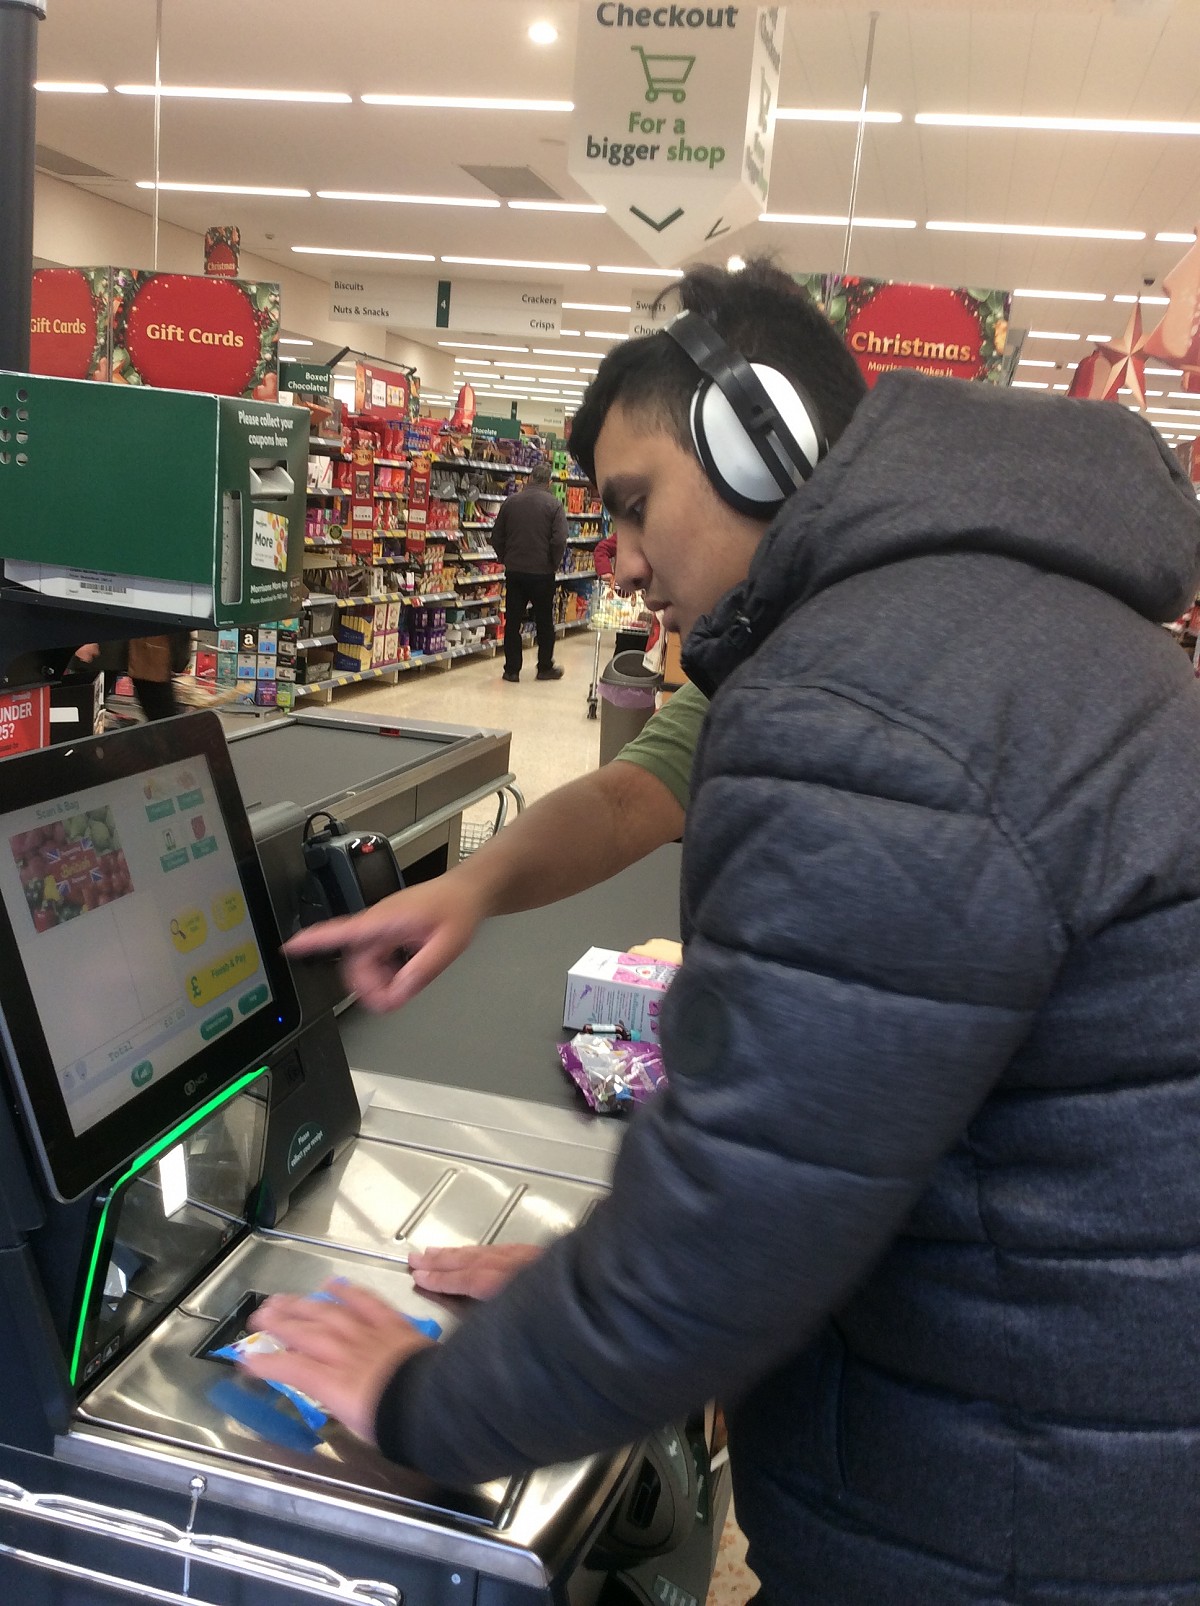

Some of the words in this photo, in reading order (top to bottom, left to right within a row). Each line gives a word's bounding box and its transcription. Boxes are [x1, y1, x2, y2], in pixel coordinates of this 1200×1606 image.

[596, 3, 739, 29] Checkout
[628, 111, 666, 134] For
[673, 119, 686, 134] a
[586, 135, 660, 167] bigger
[666, 138, 726, 170] shop
[334, 281, 364, 291] Biscuits
[521, 293, 557, 305] Crackers
[635, 300, 667, 312] Swets
[333, 305, 353, 315] Nuts
[354, 306, 361, 315] &
[362, 307, 389, 317] Snacks
[30, 317, 51, 333] Gift
[53, 318, 87, 334] Cards
[529, 319, 555, 332] Crisps
[146, 324, 184, 342] Gift
[188, 328, 244, 348] Cards
[851, 331, 976, 361] Christmas.
[305, 371, 329, 382] Boxed
[287, 380, 328, 393] Chocolates
[238, 410, 260, 426] Please
[260, 412, 280, 428] collect
[280, 419, 293, 432] your
[472, 426, 498, 436] Chocolate
[248, 434, 274, 449] coupons
[274, 432, 288, 447] here
[254, 532, 273, 549] More
[298, 1130, 310, 1146] Please
